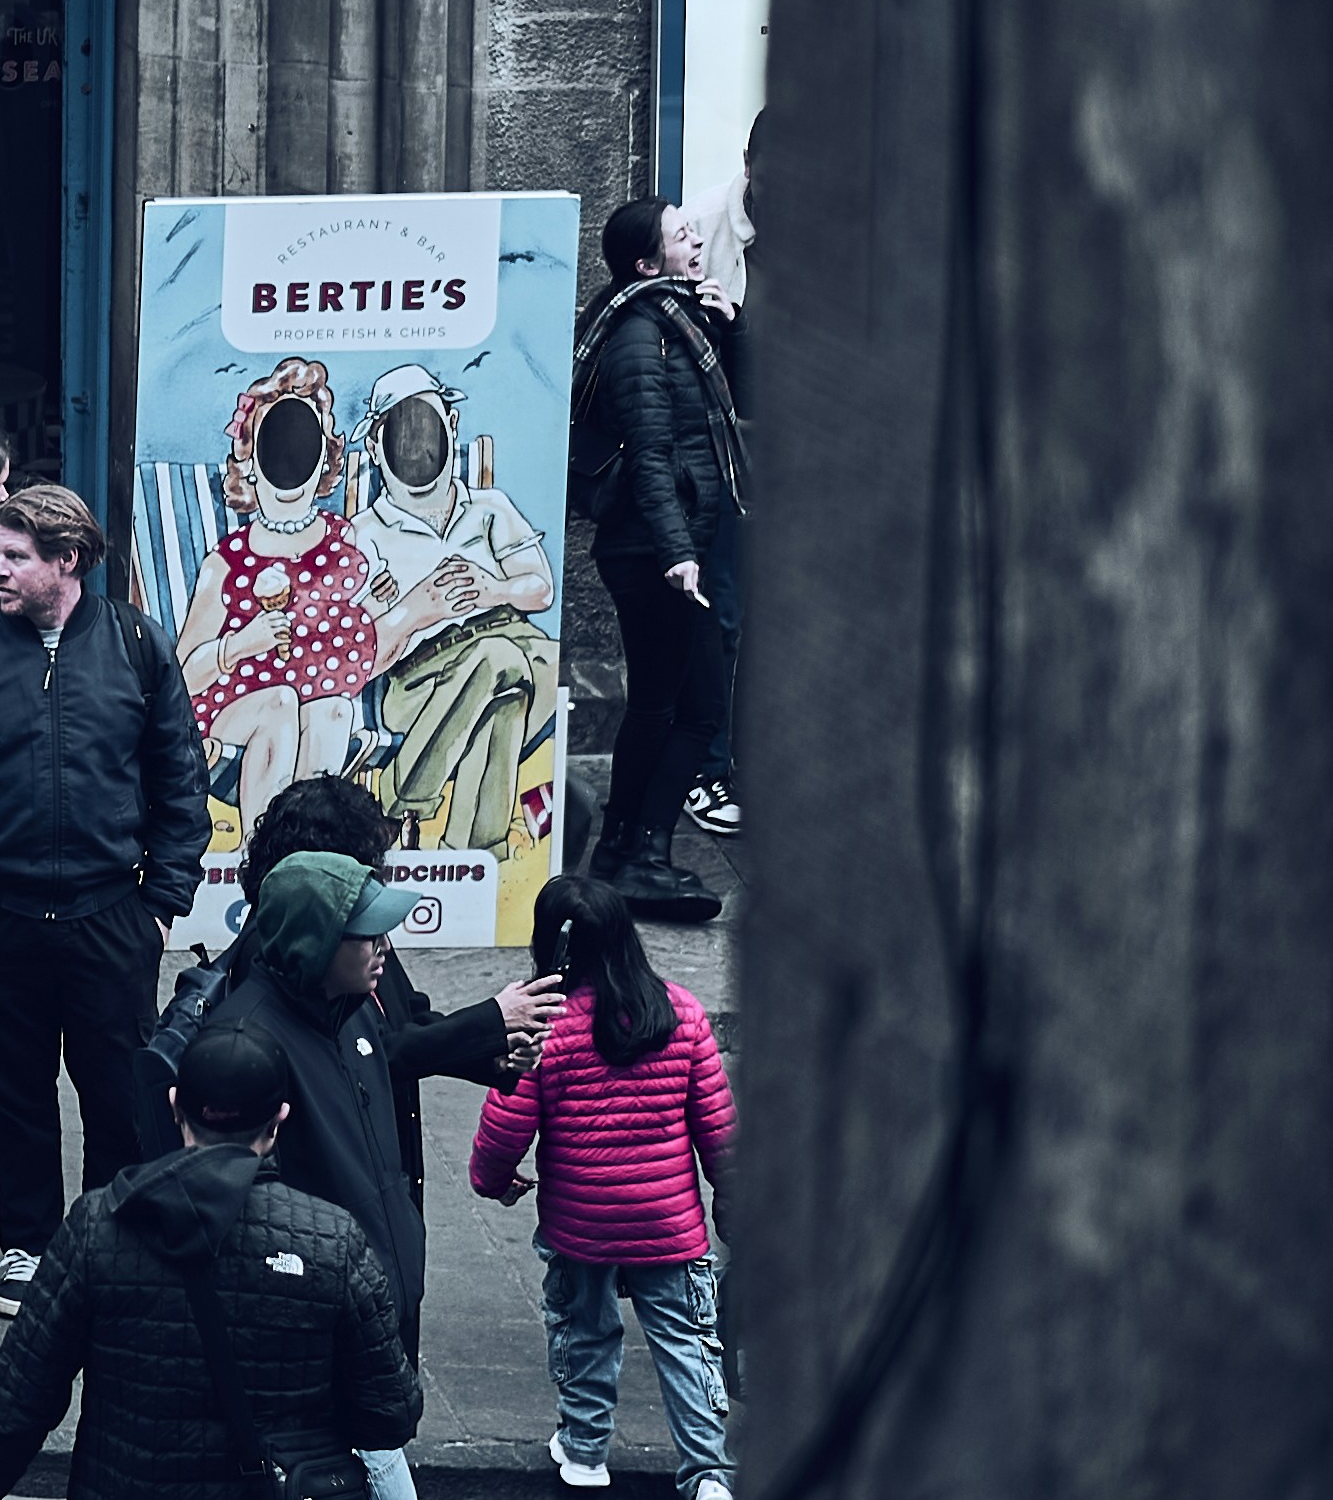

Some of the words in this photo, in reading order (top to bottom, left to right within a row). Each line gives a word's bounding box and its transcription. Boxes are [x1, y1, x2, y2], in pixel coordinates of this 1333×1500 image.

[277, 218, 392, 265] RESTAURANT
[399, 226, 410, 239] &
[416, 235, 447, 264] BAR
[251, 278, 467, 314] BERTIE'S
[273, 327, 335, 341] PROPER
[341, 327, 378, 340] FISH
[383, 327, 393, 339] &
[399, 325, 447, 339] CHIPS
